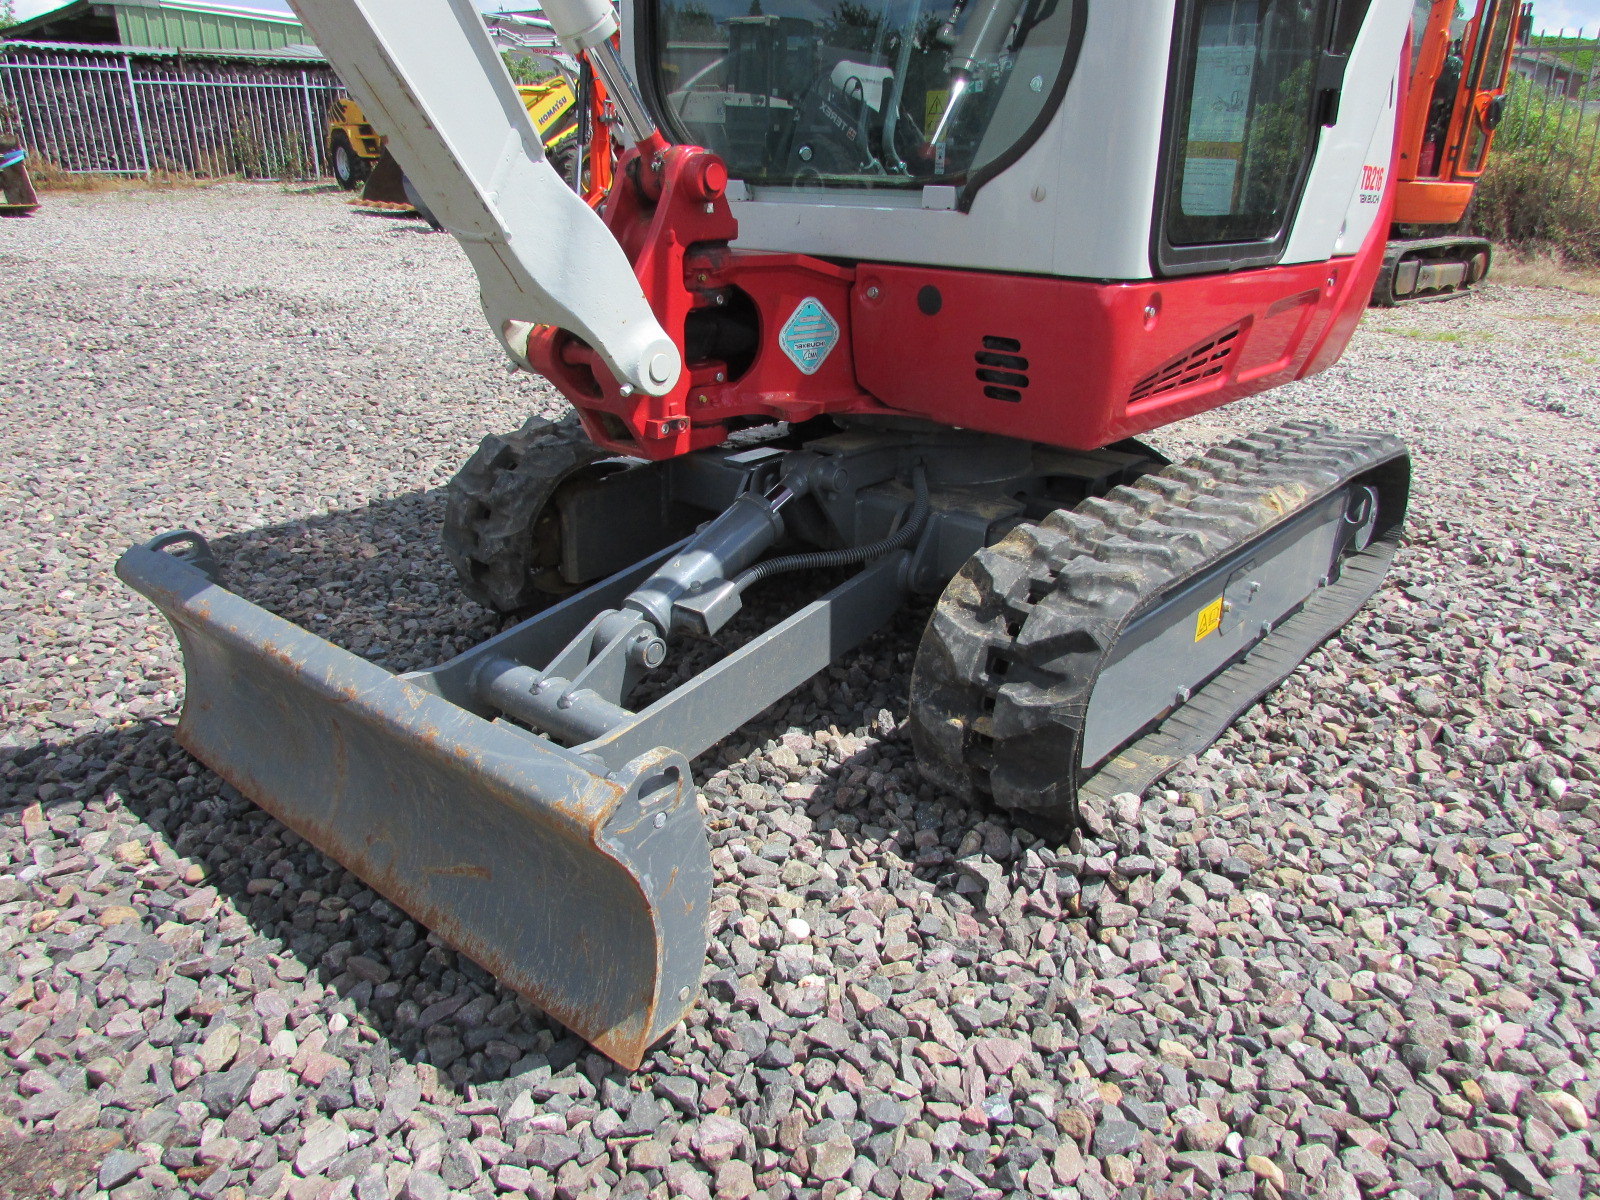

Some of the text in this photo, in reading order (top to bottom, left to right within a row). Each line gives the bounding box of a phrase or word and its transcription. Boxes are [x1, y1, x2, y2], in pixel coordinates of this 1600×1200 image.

[531, 48, 563, 56] TAKEUCHI
[538, 95, 568, 125] KOMATSU
[1360, 165, 1384, 191] TB216
[1359, 194, 1380, 204] TAKEUCHI
[794, 341, 826, 350] TAKEUCHI
